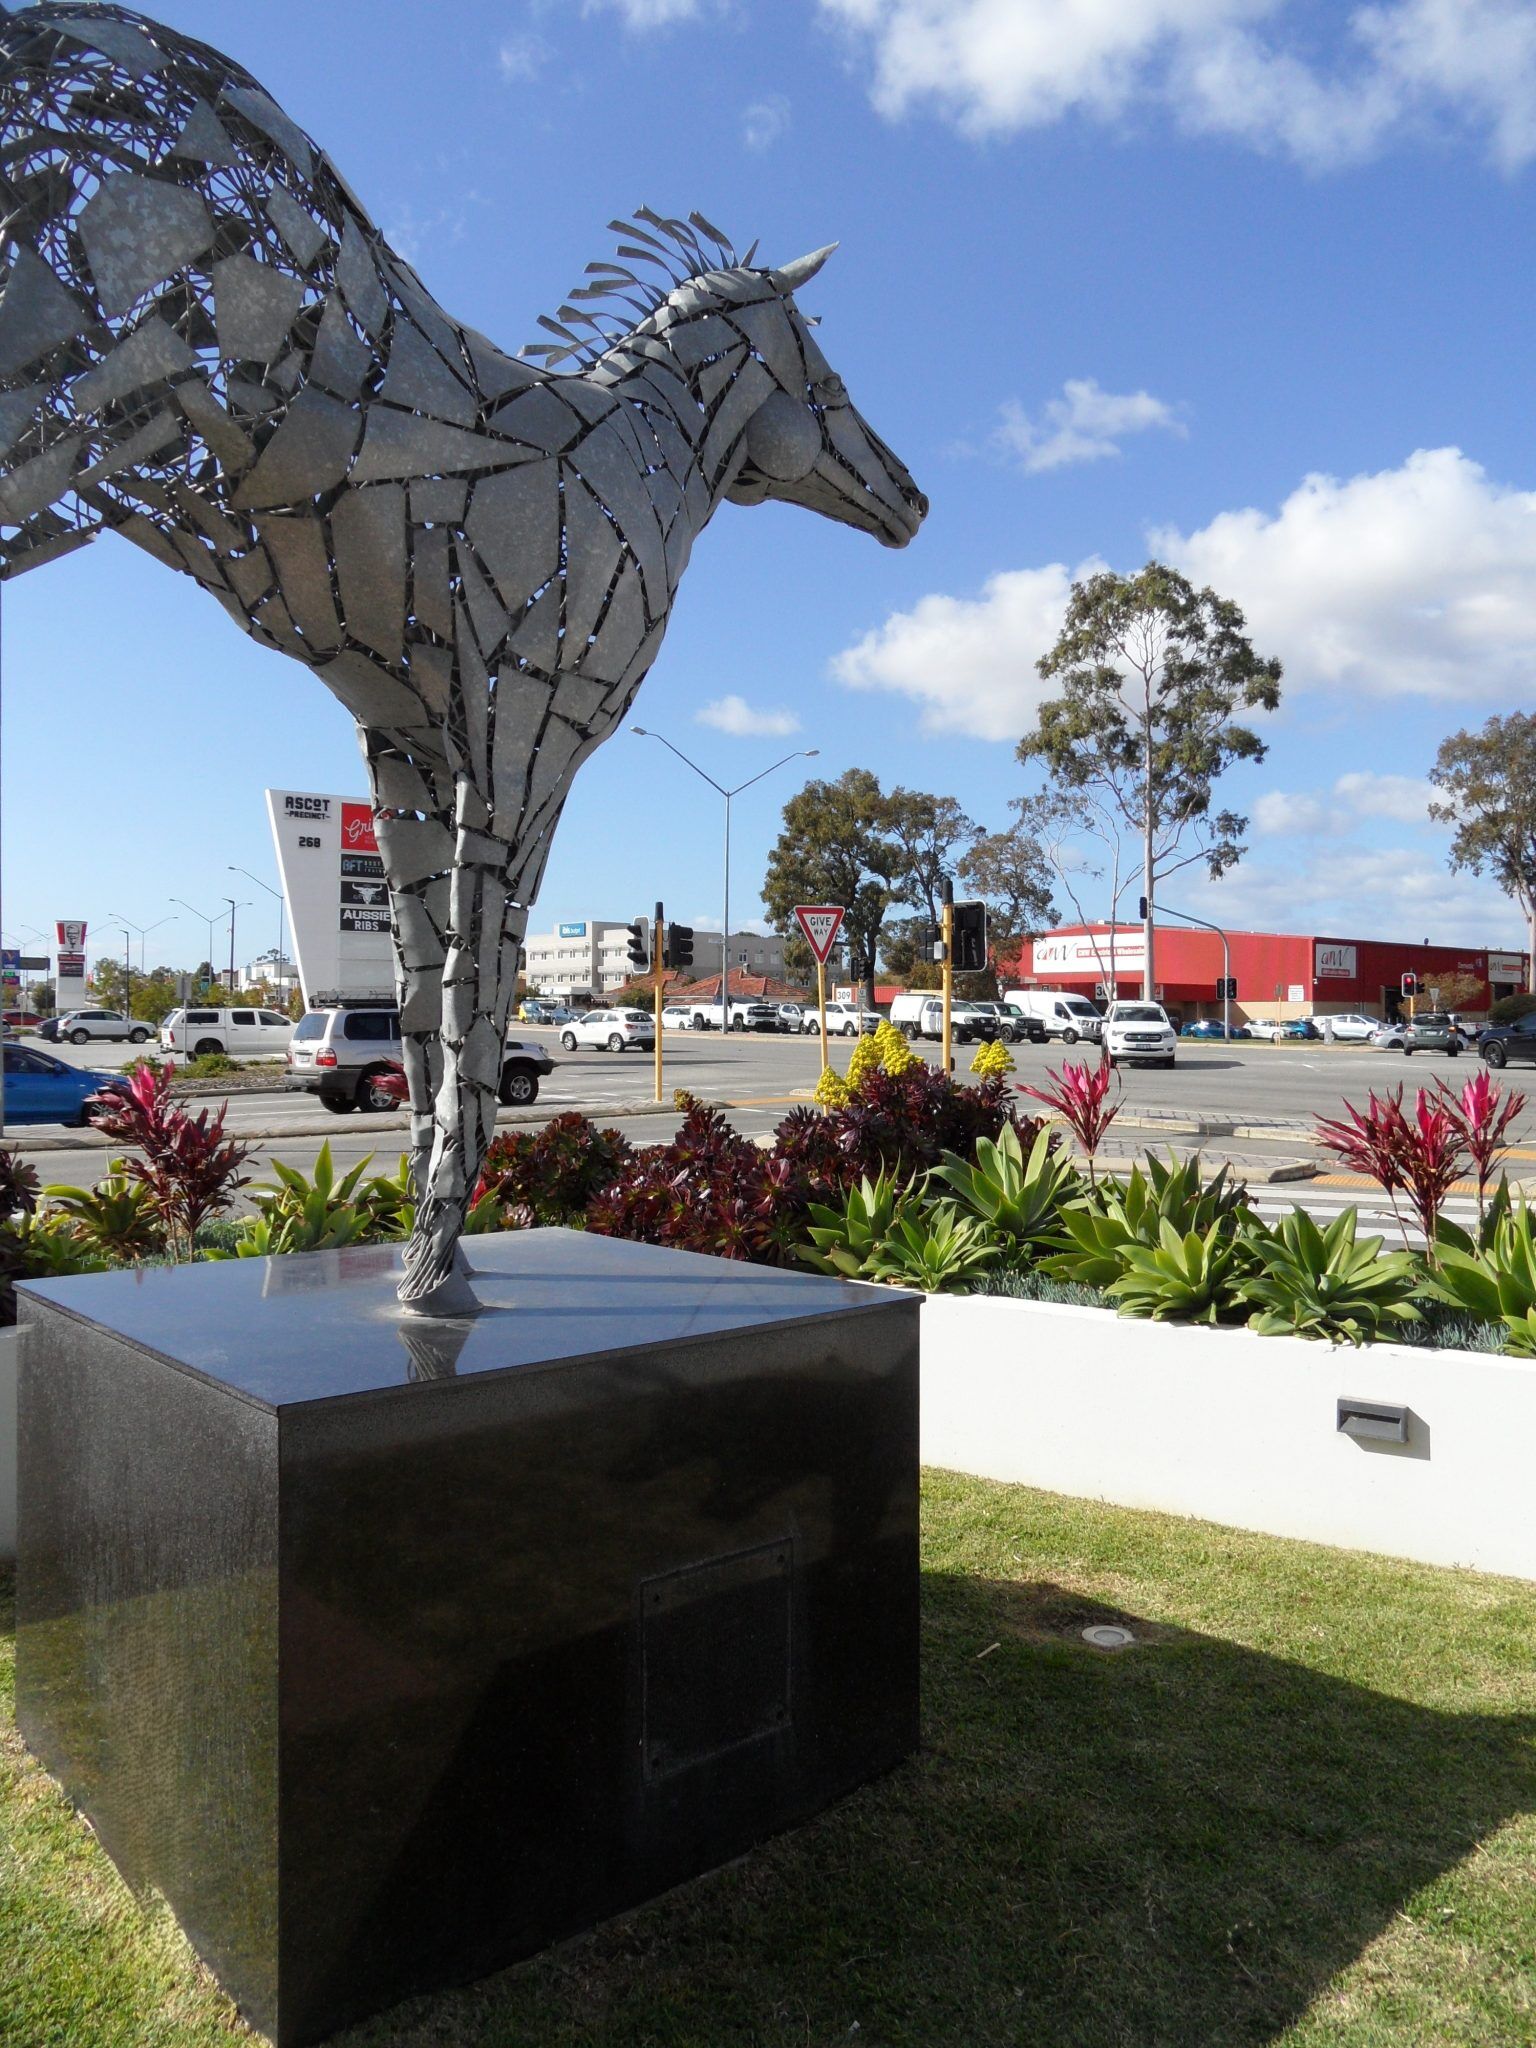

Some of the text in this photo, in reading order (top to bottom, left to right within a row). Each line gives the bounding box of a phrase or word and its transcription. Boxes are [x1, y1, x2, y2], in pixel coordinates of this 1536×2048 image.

[285, 796, 330, 811] ASCOT
[298, 836, 321, 848] 268
[342, 909, 391, 921] AUSSIE
[354, 920, 379, 931] RIBS
[810, 916, 832, 926] GIVE
[814, 928, 829, 936] WAY
[837, 991, 851, 1000] 309
